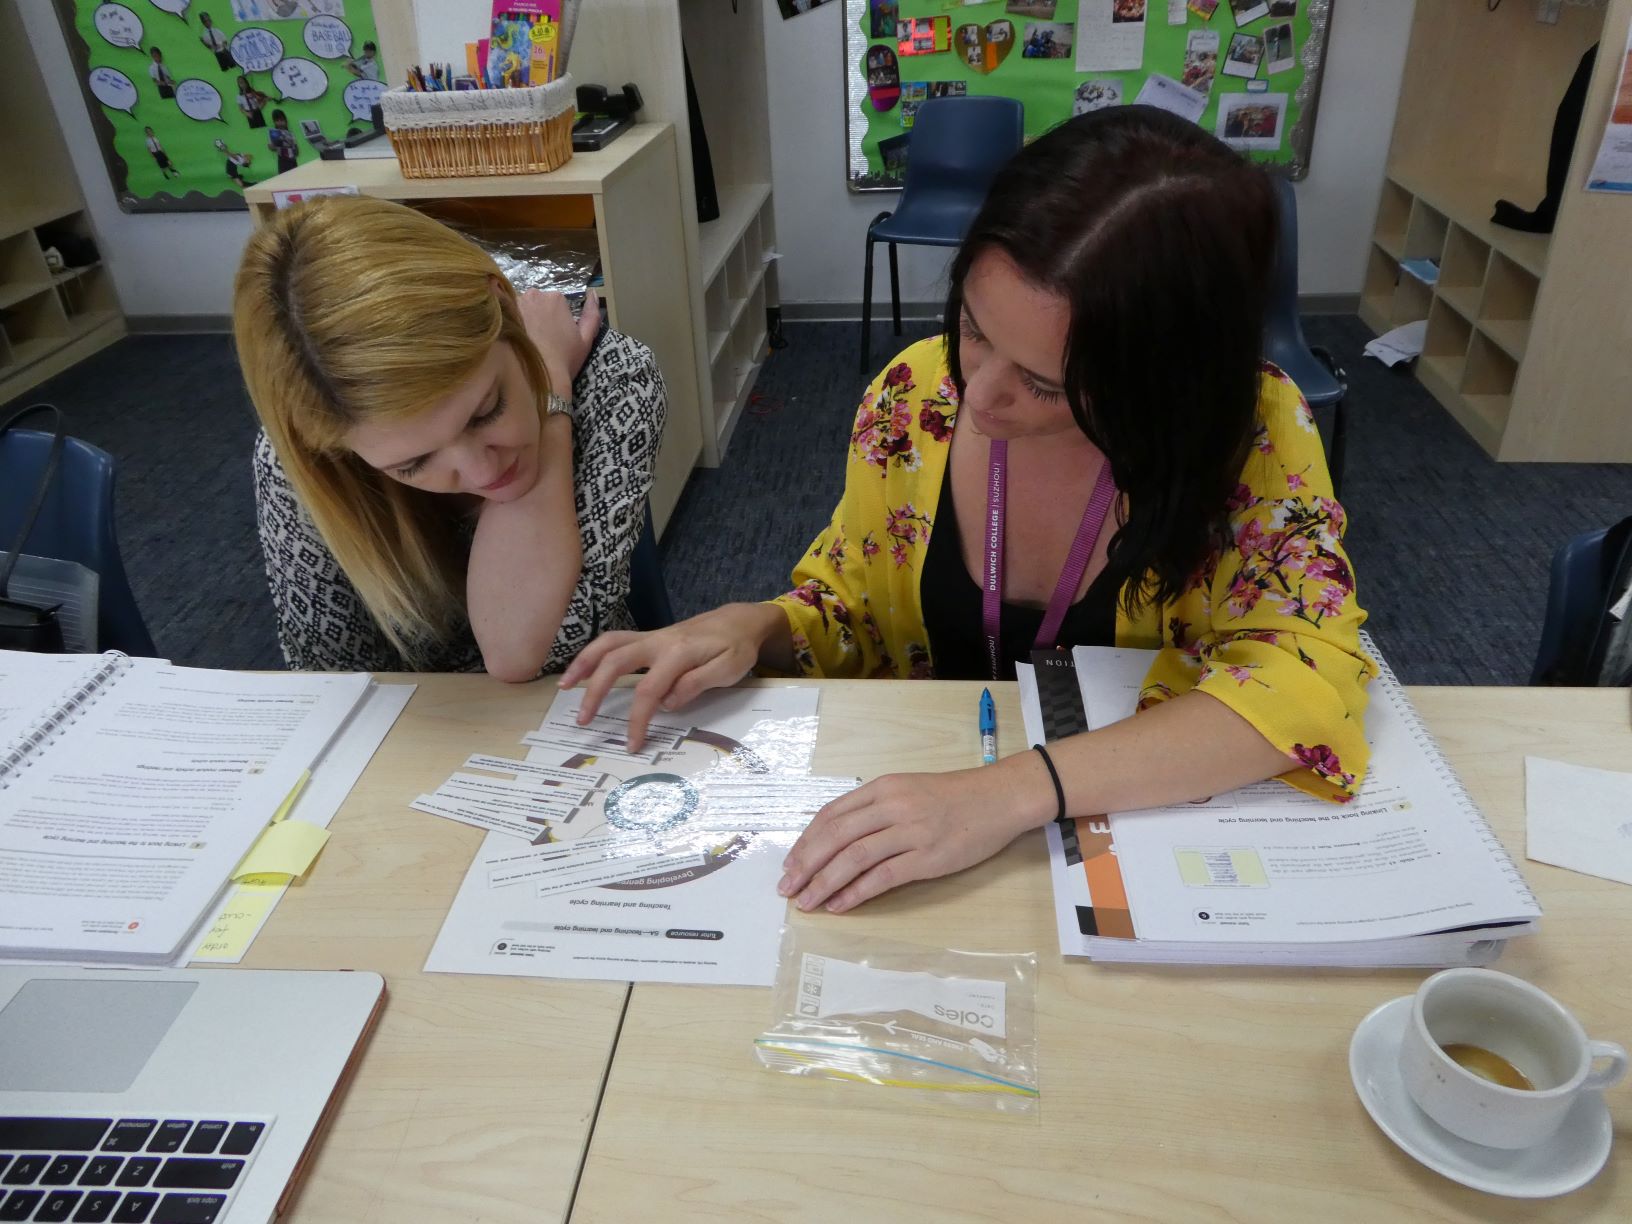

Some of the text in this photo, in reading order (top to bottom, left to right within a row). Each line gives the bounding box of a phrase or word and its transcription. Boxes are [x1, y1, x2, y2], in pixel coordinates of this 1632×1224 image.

[989, 467, 1001, 591] DULWICH COLLEGE SUZHOU
[1360, 807, 1387, 817] Linking
[1218, 816, 1237, 824] cycle
[1285, 815, 1316, 824] teaching
[646, 869, 695, 886] Developing
[569, 898, 672, 911] Teaching and learning cycle
[572, 925, 599, 934] learning
[600, 927, 613, 935] and
[933, 1004, 995, 1029] coles
[19, 1163, 30, 1174] V
[57, 1164, 68, 1174] C
[94, 1165, 107, 1174] X
[132, 1165, 144, 1176] Z
[13, 1199, 24, 1210] F
[52, 1199, 64, 1211] D
[90, 1200, 102, 1211] S
[131, 1201, 142, 1212] A
